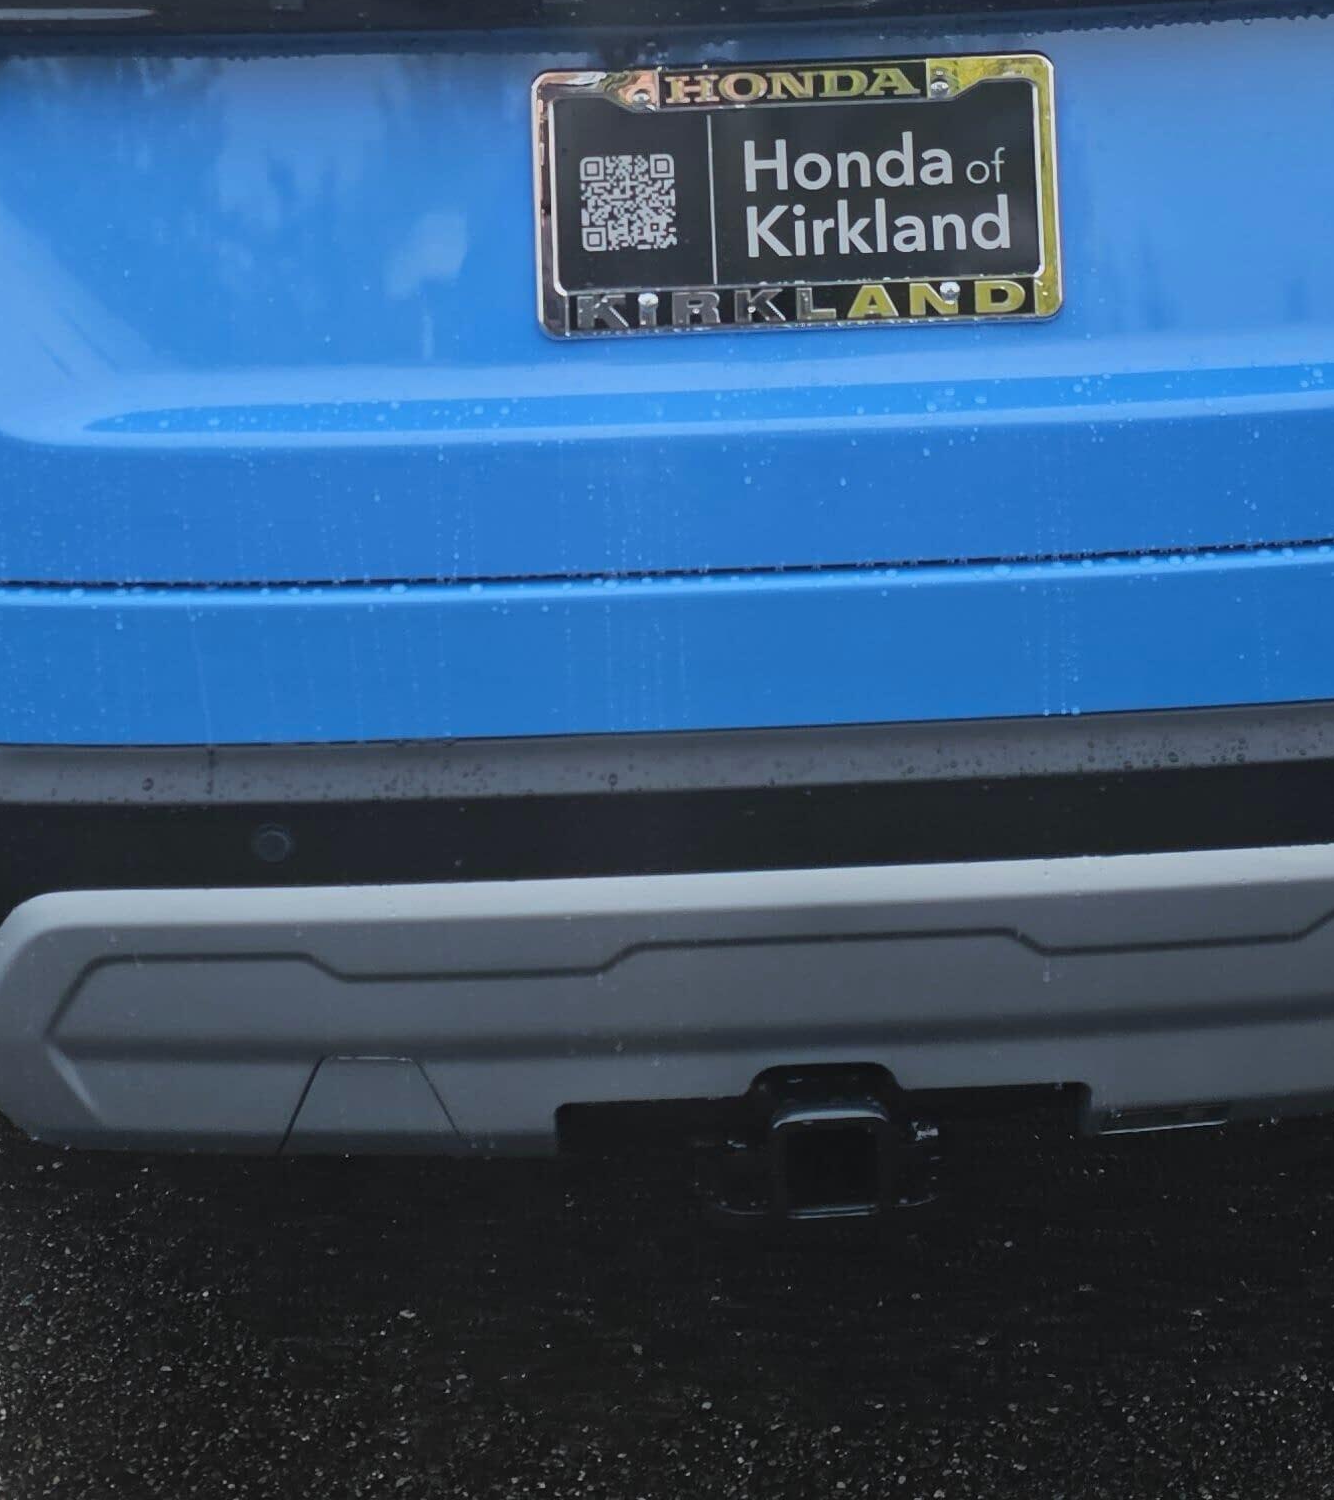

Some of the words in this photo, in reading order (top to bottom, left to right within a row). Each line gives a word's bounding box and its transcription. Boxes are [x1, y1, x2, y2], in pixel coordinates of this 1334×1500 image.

[665, 67, 920, 106] HONDA
[743, 131, 954, 192] Honda
[966, 146, 1006, 185] of
[746, 194, 1012, 258] Kirkland
[575, 278, 1027, 328] KIRKLAND
